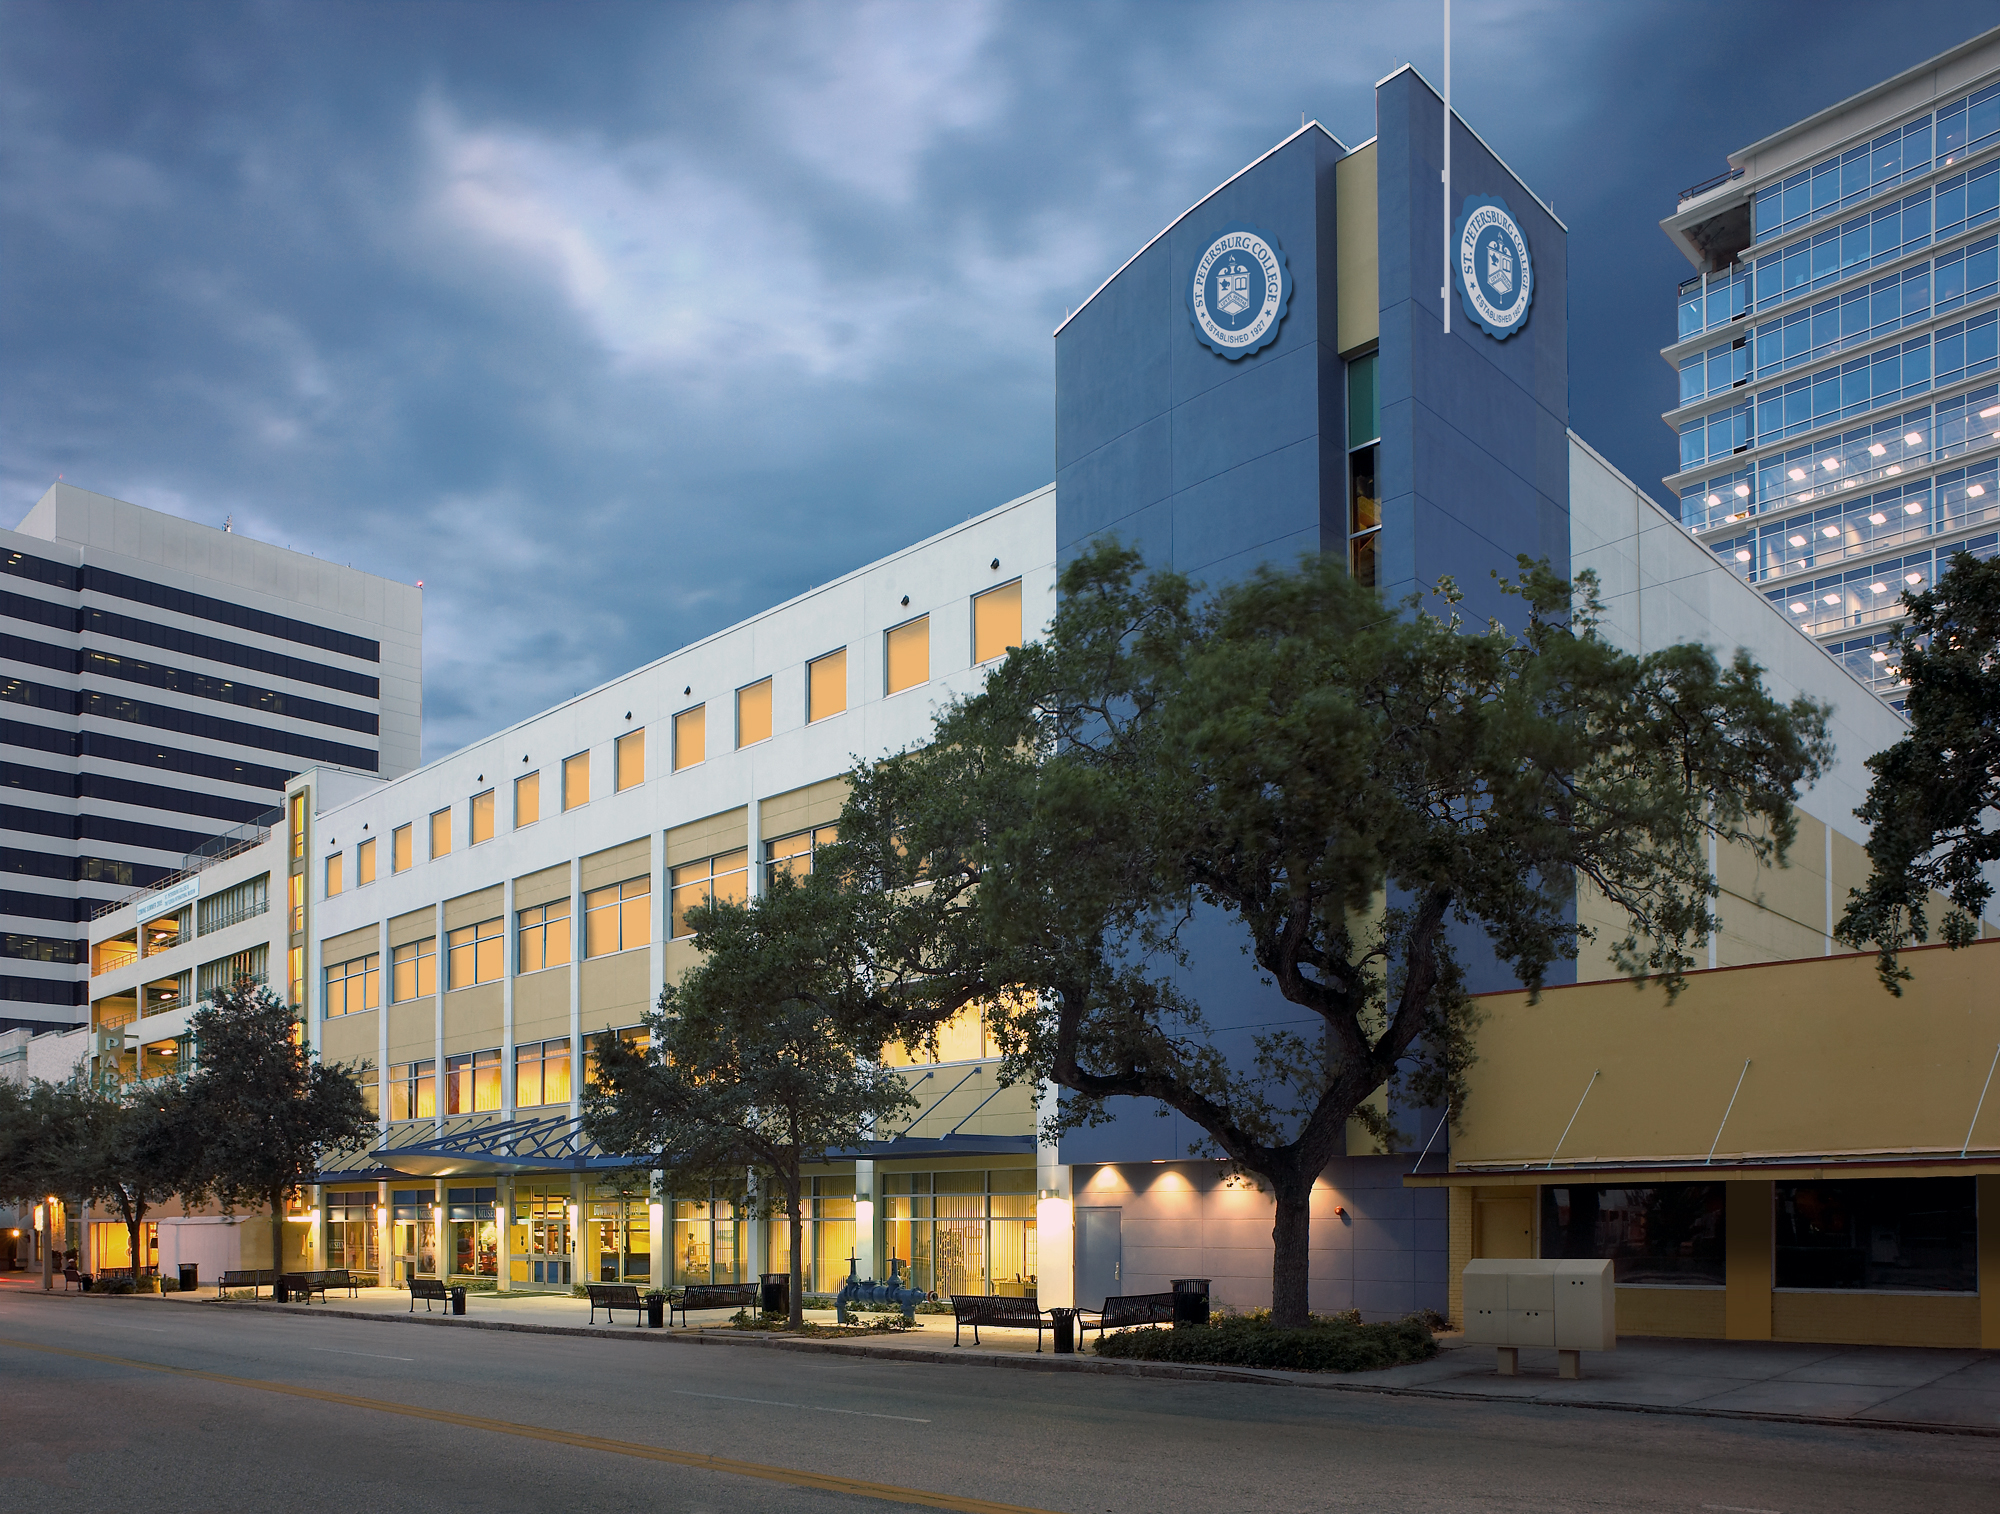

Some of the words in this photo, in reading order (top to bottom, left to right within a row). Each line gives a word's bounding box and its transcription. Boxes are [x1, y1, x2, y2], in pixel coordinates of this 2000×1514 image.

[1464, 210, 1514, 249] PETERSBURG
[1196, 236, 1251, 286] PETERSBURG
[1252, 242, 1279, 303] COLLEGE
[1463, 252, 1473, 275] ST.
[1514, 234, 1529, 292] COLLEGE
[1194, 289, 1204, 308] ST.
[1475, 294, 1513, 324] ESTABLISHED
[1512, 304, 1522, 318] 1927
[1205, 320, 1249, 344] ESTABLISHED
[1250, 320, 1266, 338] 1927
[104, 1037, 120, 1103] PARK
